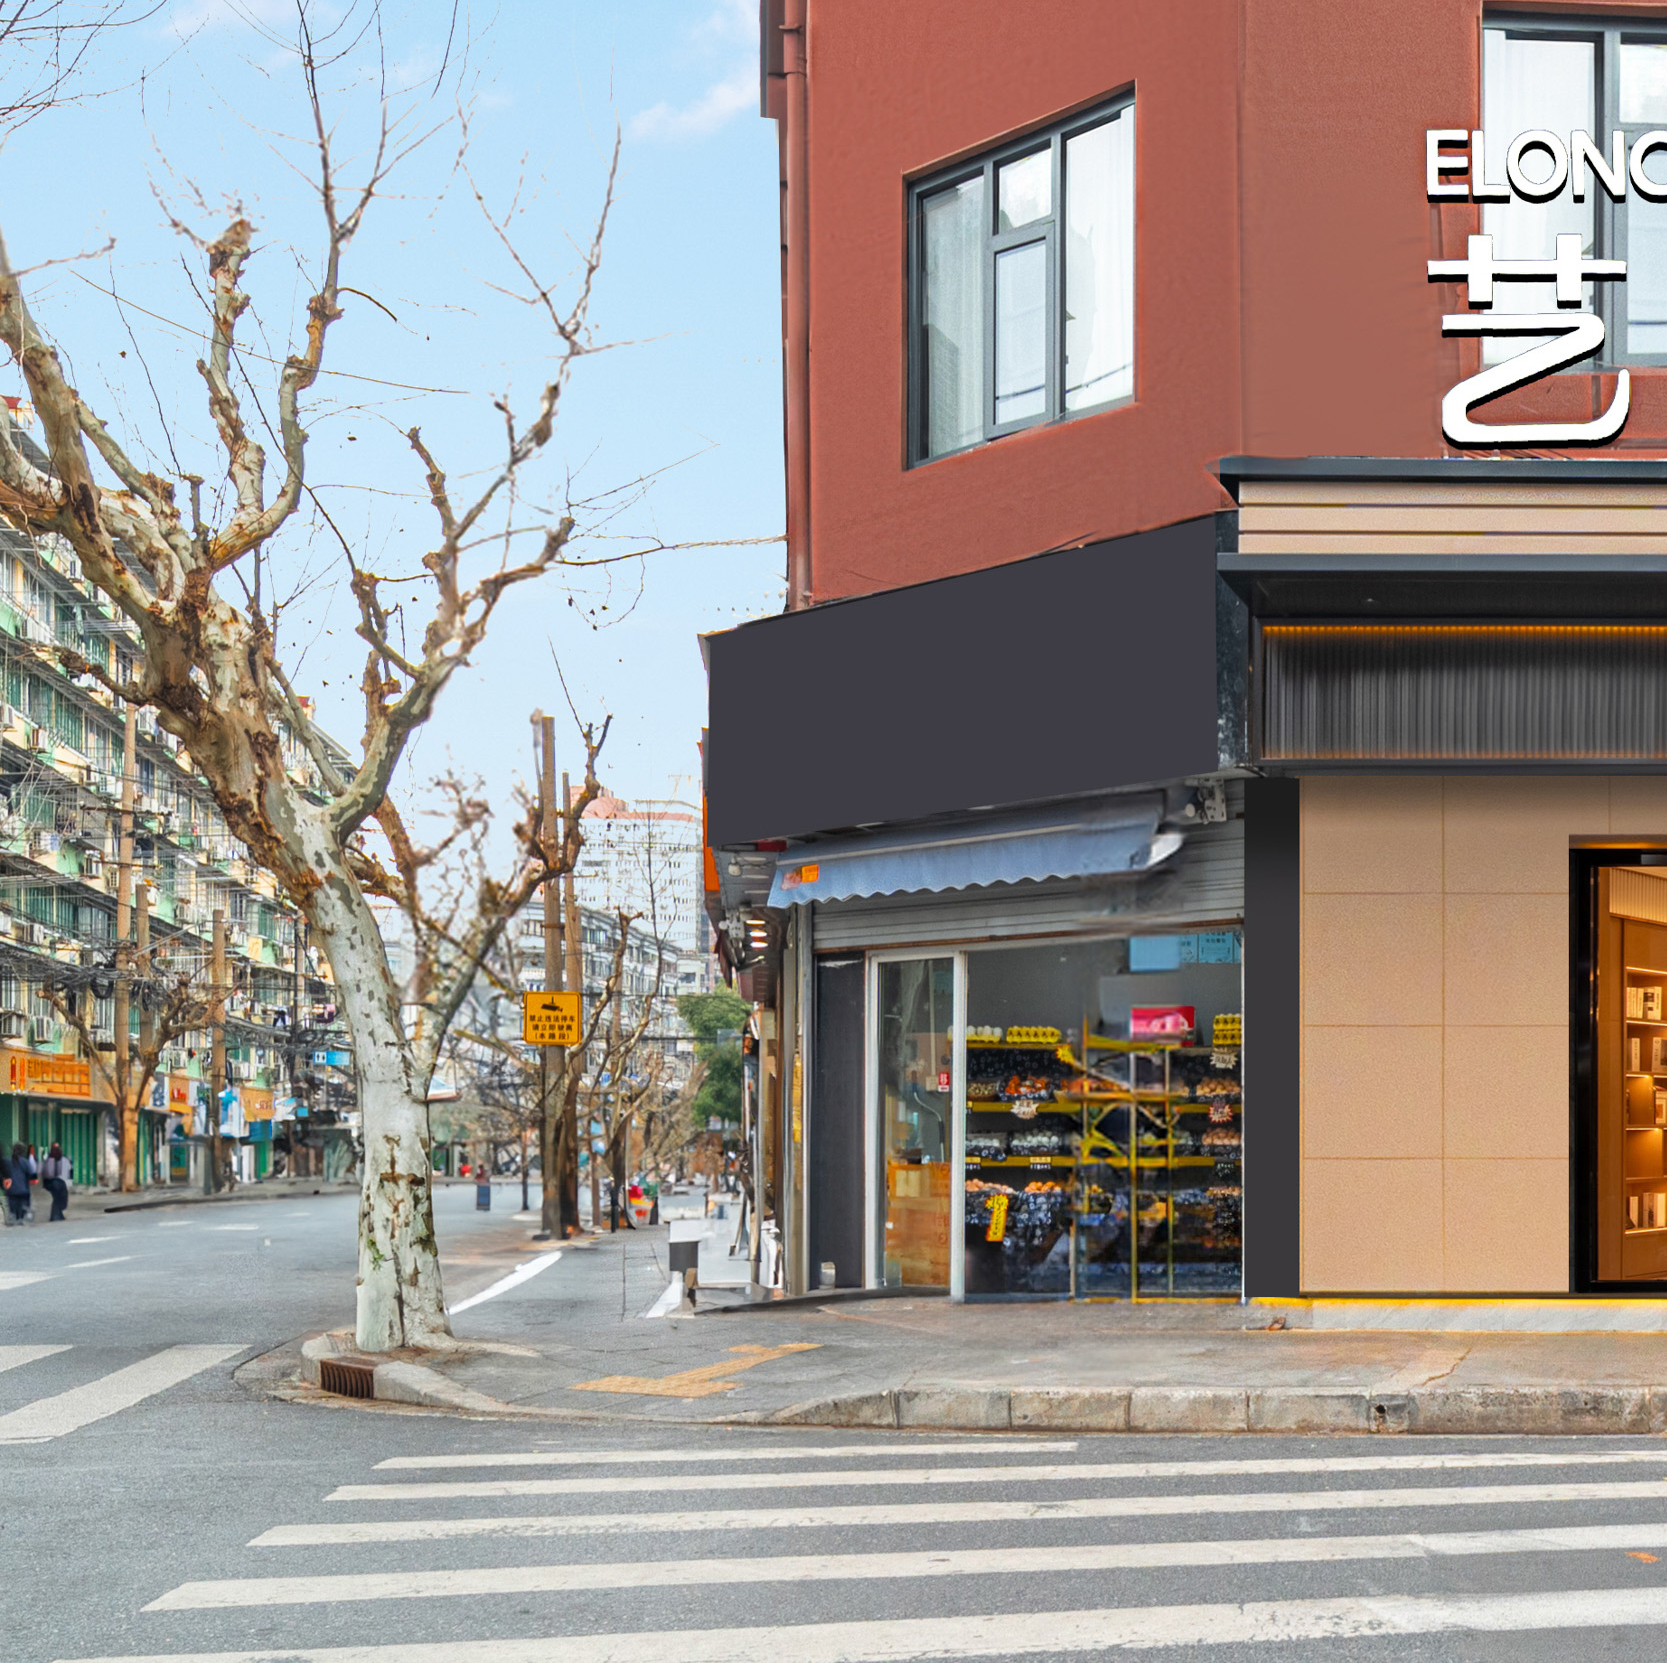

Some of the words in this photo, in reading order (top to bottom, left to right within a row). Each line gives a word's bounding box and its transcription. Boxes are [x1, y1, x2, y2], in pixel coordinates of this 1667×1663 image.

[529, 1014, 575, 1023] 禁止违法停车
